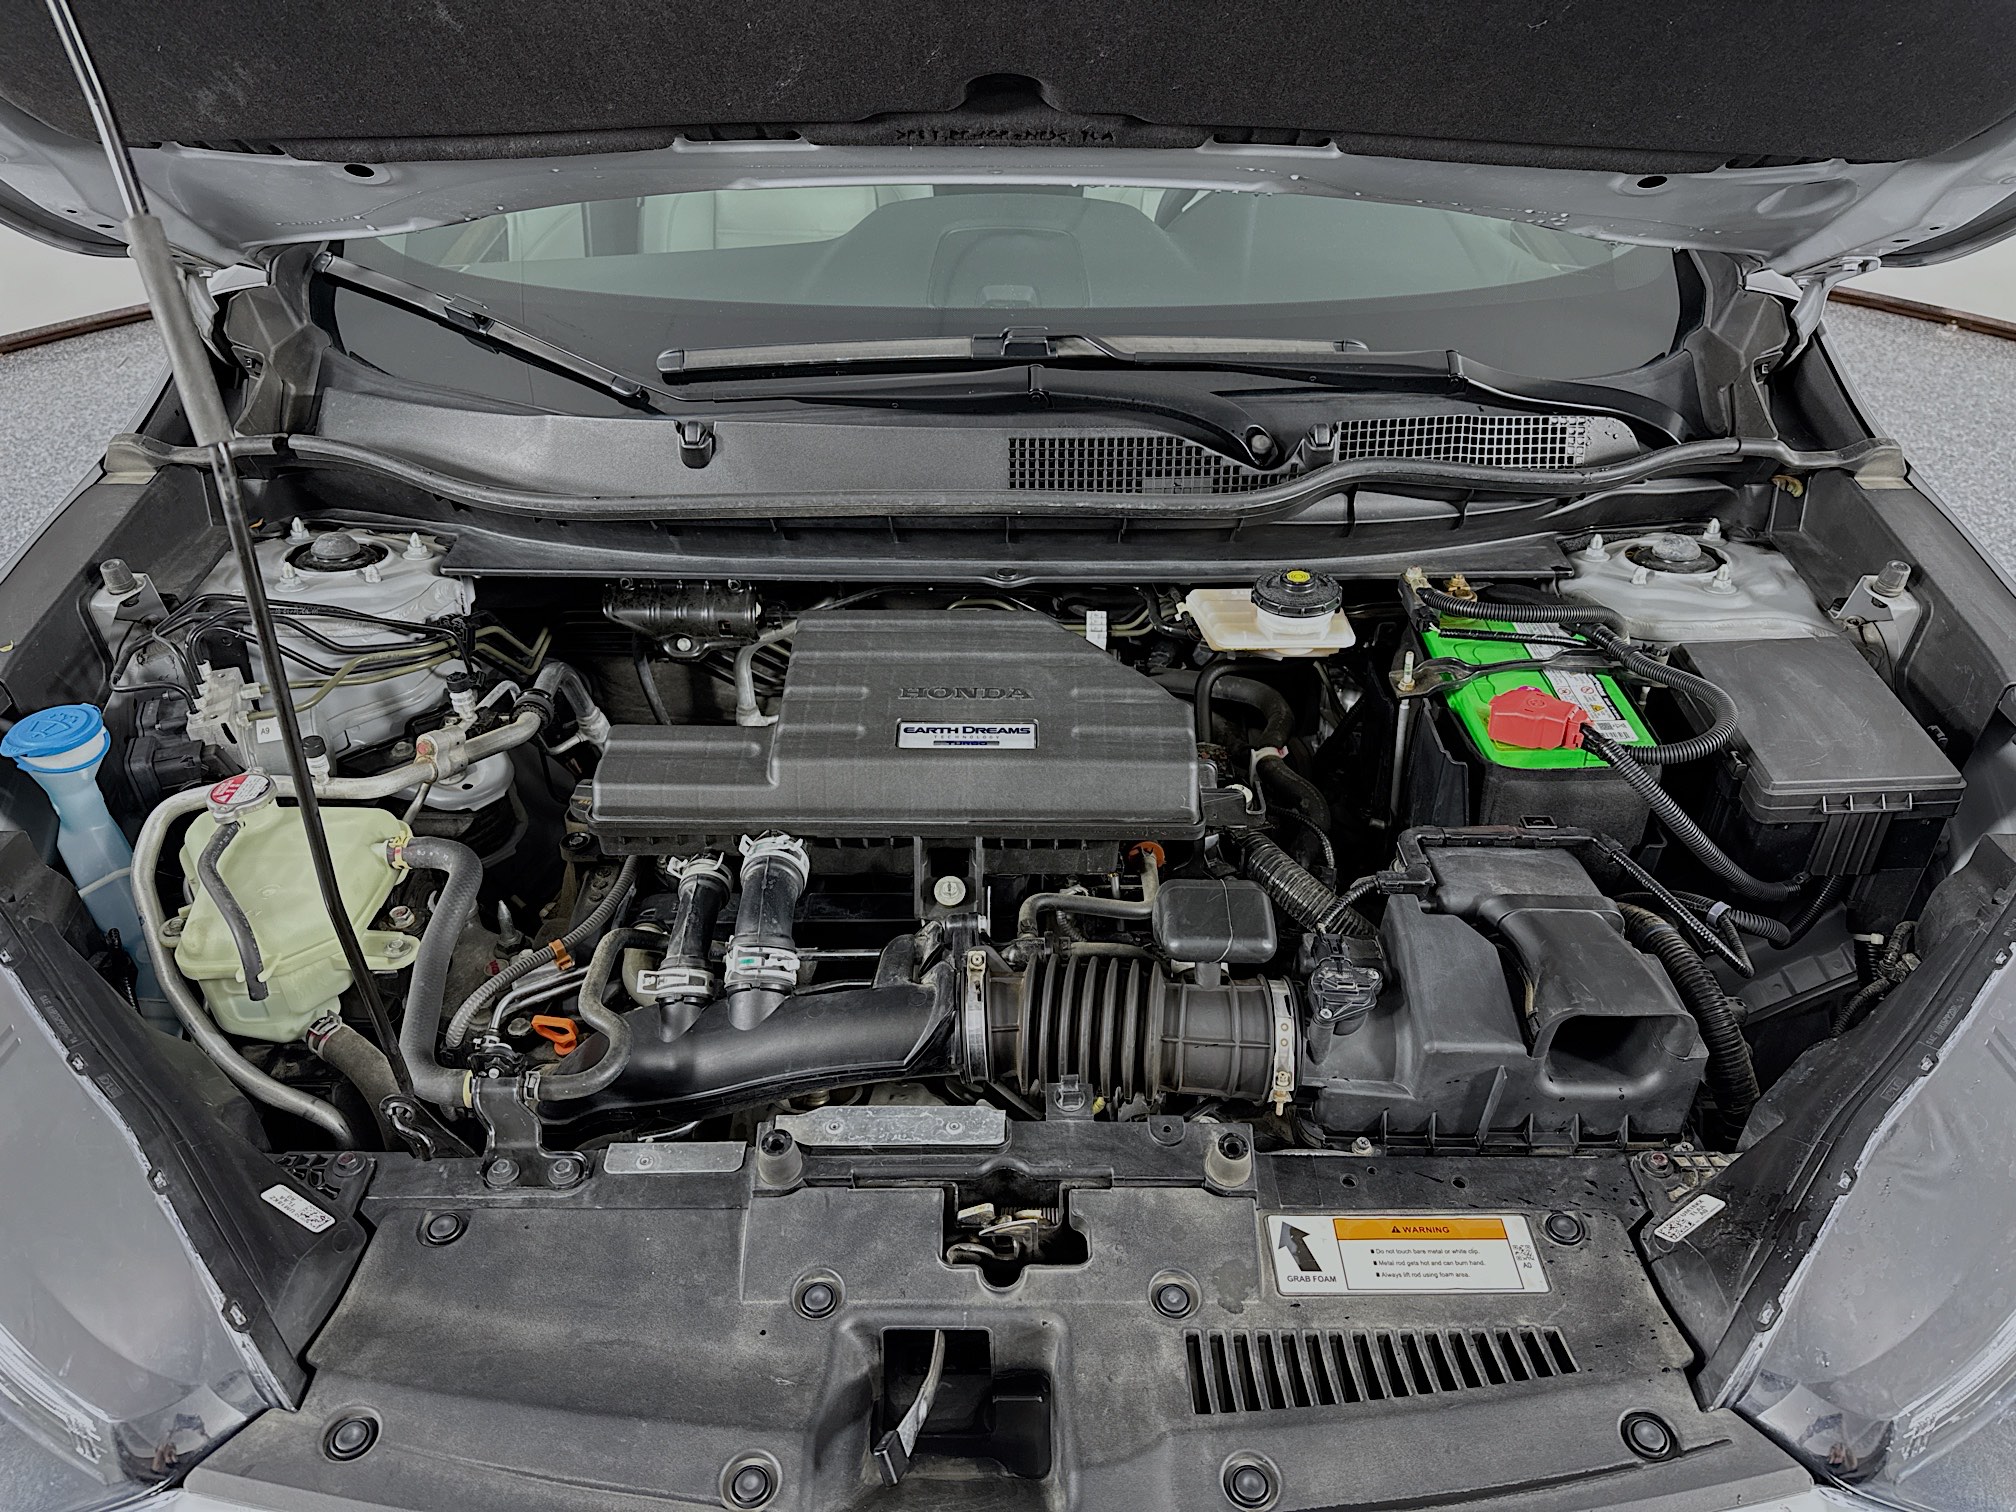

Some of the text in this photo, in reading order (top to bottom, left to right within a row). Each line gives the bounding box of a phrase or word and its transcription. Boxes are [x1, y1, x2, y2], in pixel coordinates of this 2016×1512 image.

[898, 687, 1035, 700] HONDA
[903, 726, 1031, 734] EARTH DREAMS
[1468, 1247, 1480, 1255] clip.
[1287, 1274, 1337, 1283] GRAB FOAM
